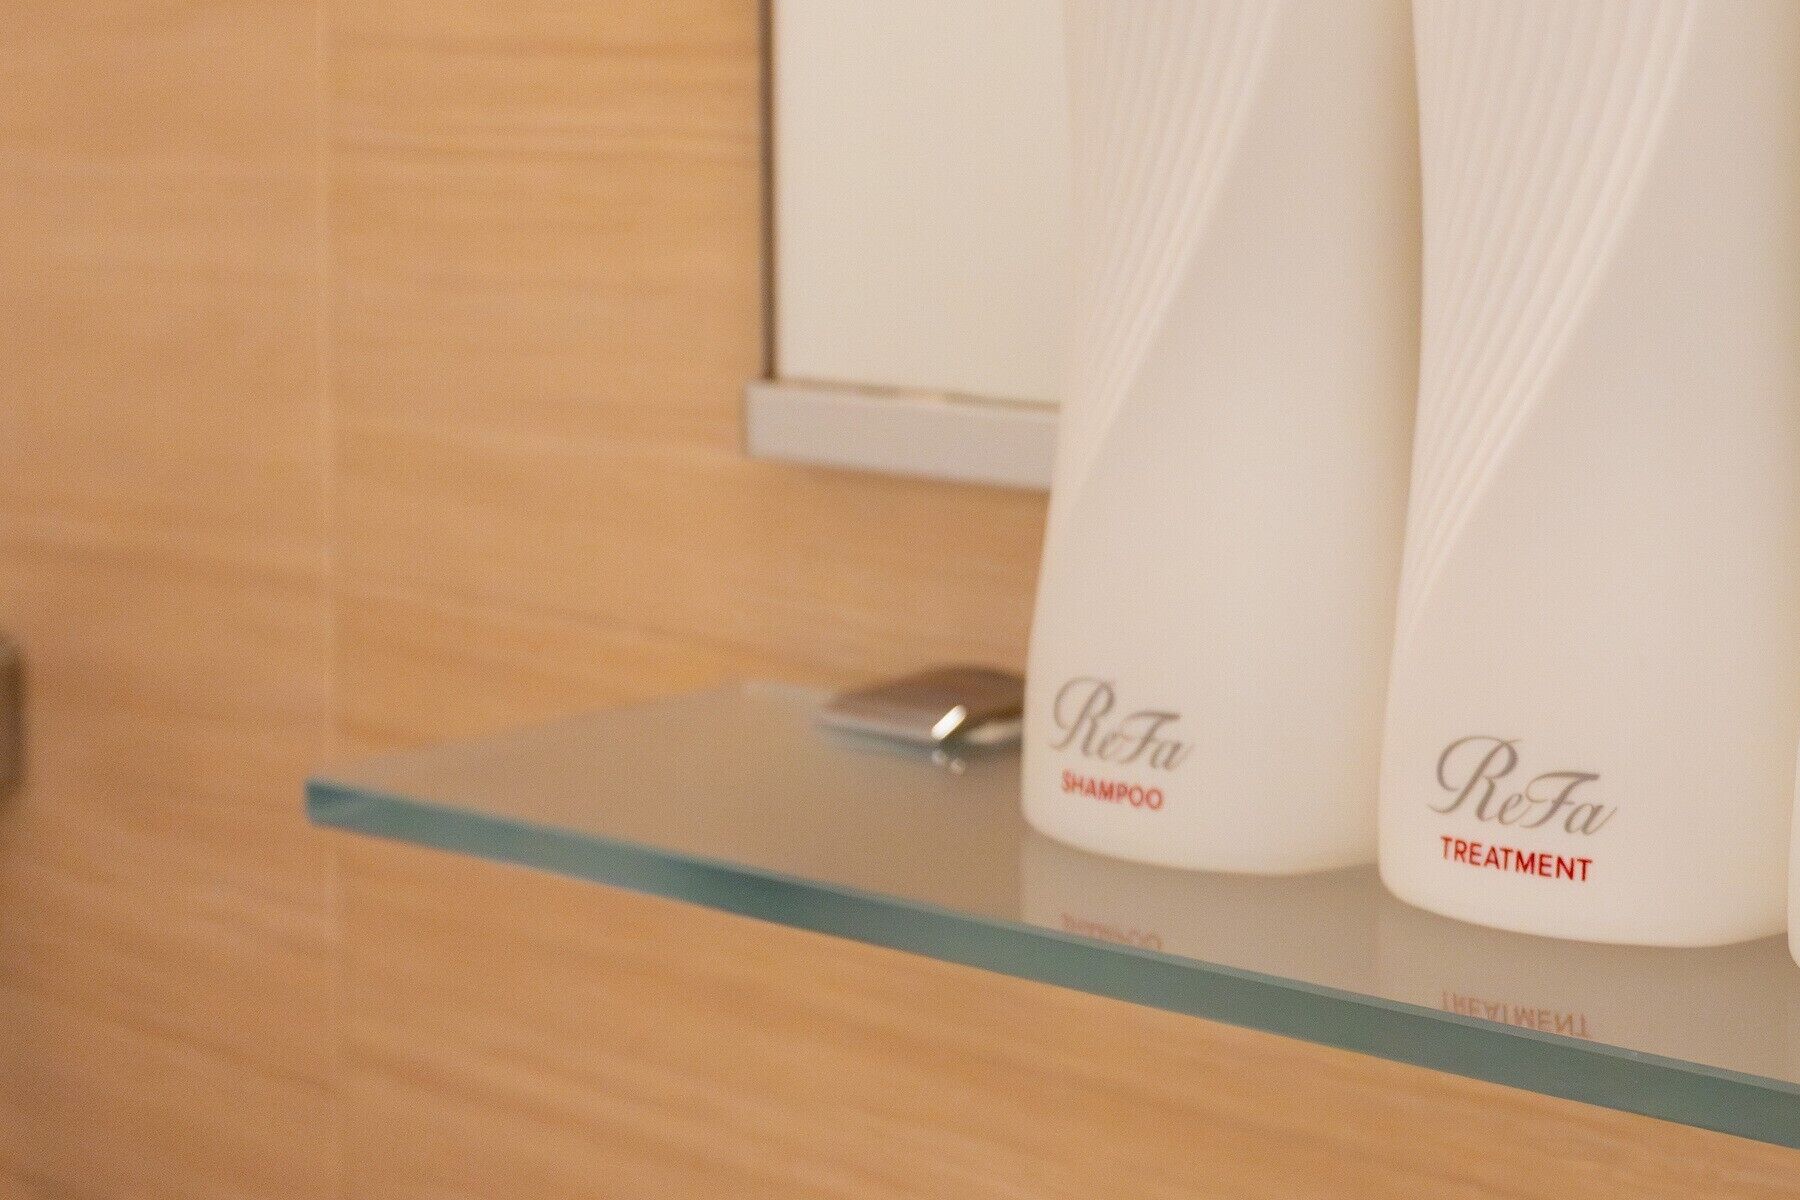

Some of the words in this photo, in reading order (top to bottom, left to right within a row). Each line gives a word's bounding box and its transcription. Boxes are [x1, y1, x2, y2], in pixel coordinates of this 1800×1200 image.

[1051, 676, 1193, 769] ReFa
[1062, 772, 1163, 810] SHAMPOO
[1428, 735, 1618, 835] ReFa
[1441, 836, 1593, 881] TREATMENT
